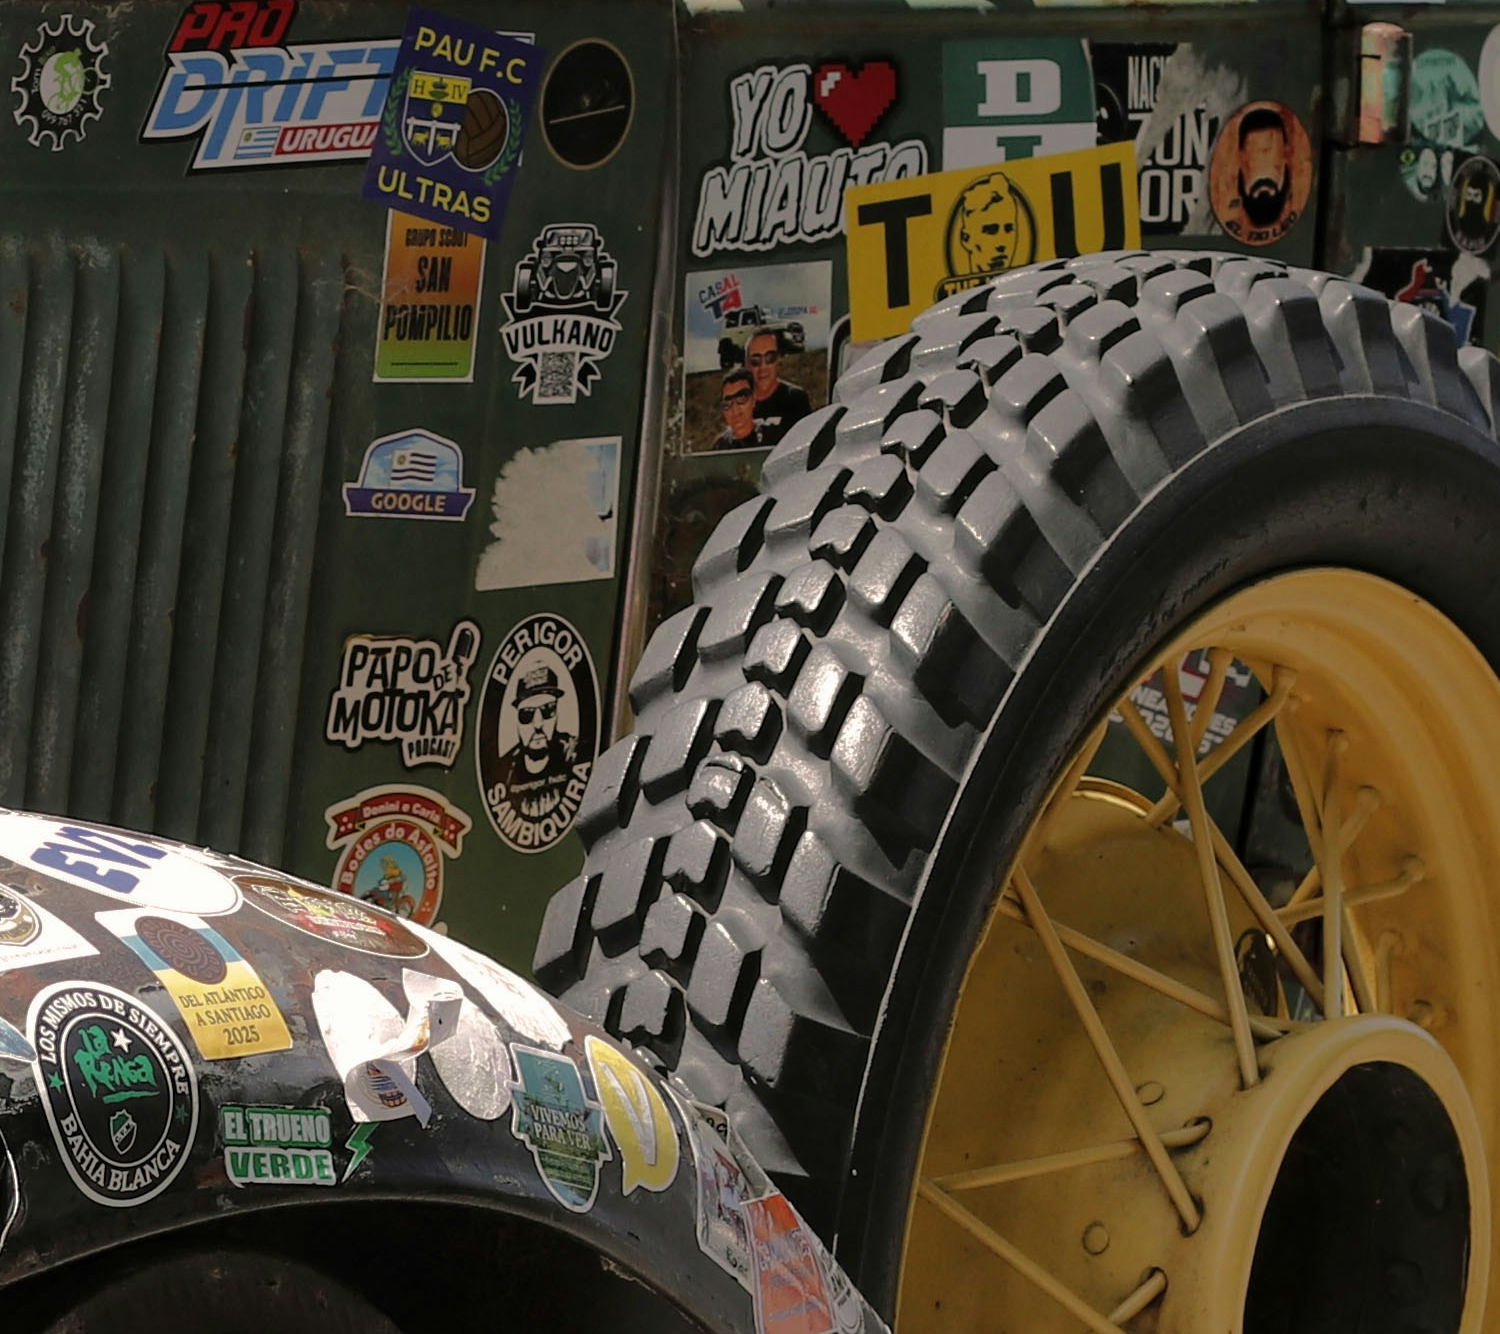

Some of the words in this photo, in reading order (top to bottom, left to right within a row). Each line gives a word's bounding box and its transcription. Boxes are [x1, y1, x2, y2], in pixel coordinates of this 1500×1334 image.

[173, 0, 287, 51] PRO
[414, 27, 475, 67] PAU
[479, 50, 527, 84] F.C
[377, 165, 492, 223] ULTRAS
[416, 256, 452, 294] SAN
[383, 304, 473, 342] POMPILIO
[506, 318, 613, 355] VULKANO
[370, 493, 446, 513] GOOGLE
[493, 620, 584, 684] PERIGOR
[333, 690, 460, 740] MOTOKA
[408, 739, 457, 761] PODCAST
[488, 761, 592, 846] SAMBIQUIRA
[44, 992, 97, 1031] MISMOS
[100, 994, 127, 1014] DE
[179, 994, 205, 1009] DEL
[206, 986, 265, 1005] ATLÁNTICO
[38, 1031, 58, 1064] LOS
[129, 1009, 188, 1094] SIEMPRE
[222, 1026, 260, 1045] 2025
[224, 1112, 248, 1141] EL
[249, 1114, 330, 1143] TRUENO
[529, 1105, 587, 1134] VIVEMOS
[60, 1113, 105, 1187] BAHIA
[107, 1139, 181, 1192] BLANCA
[229, 1150, 334, 1180] VERDE
